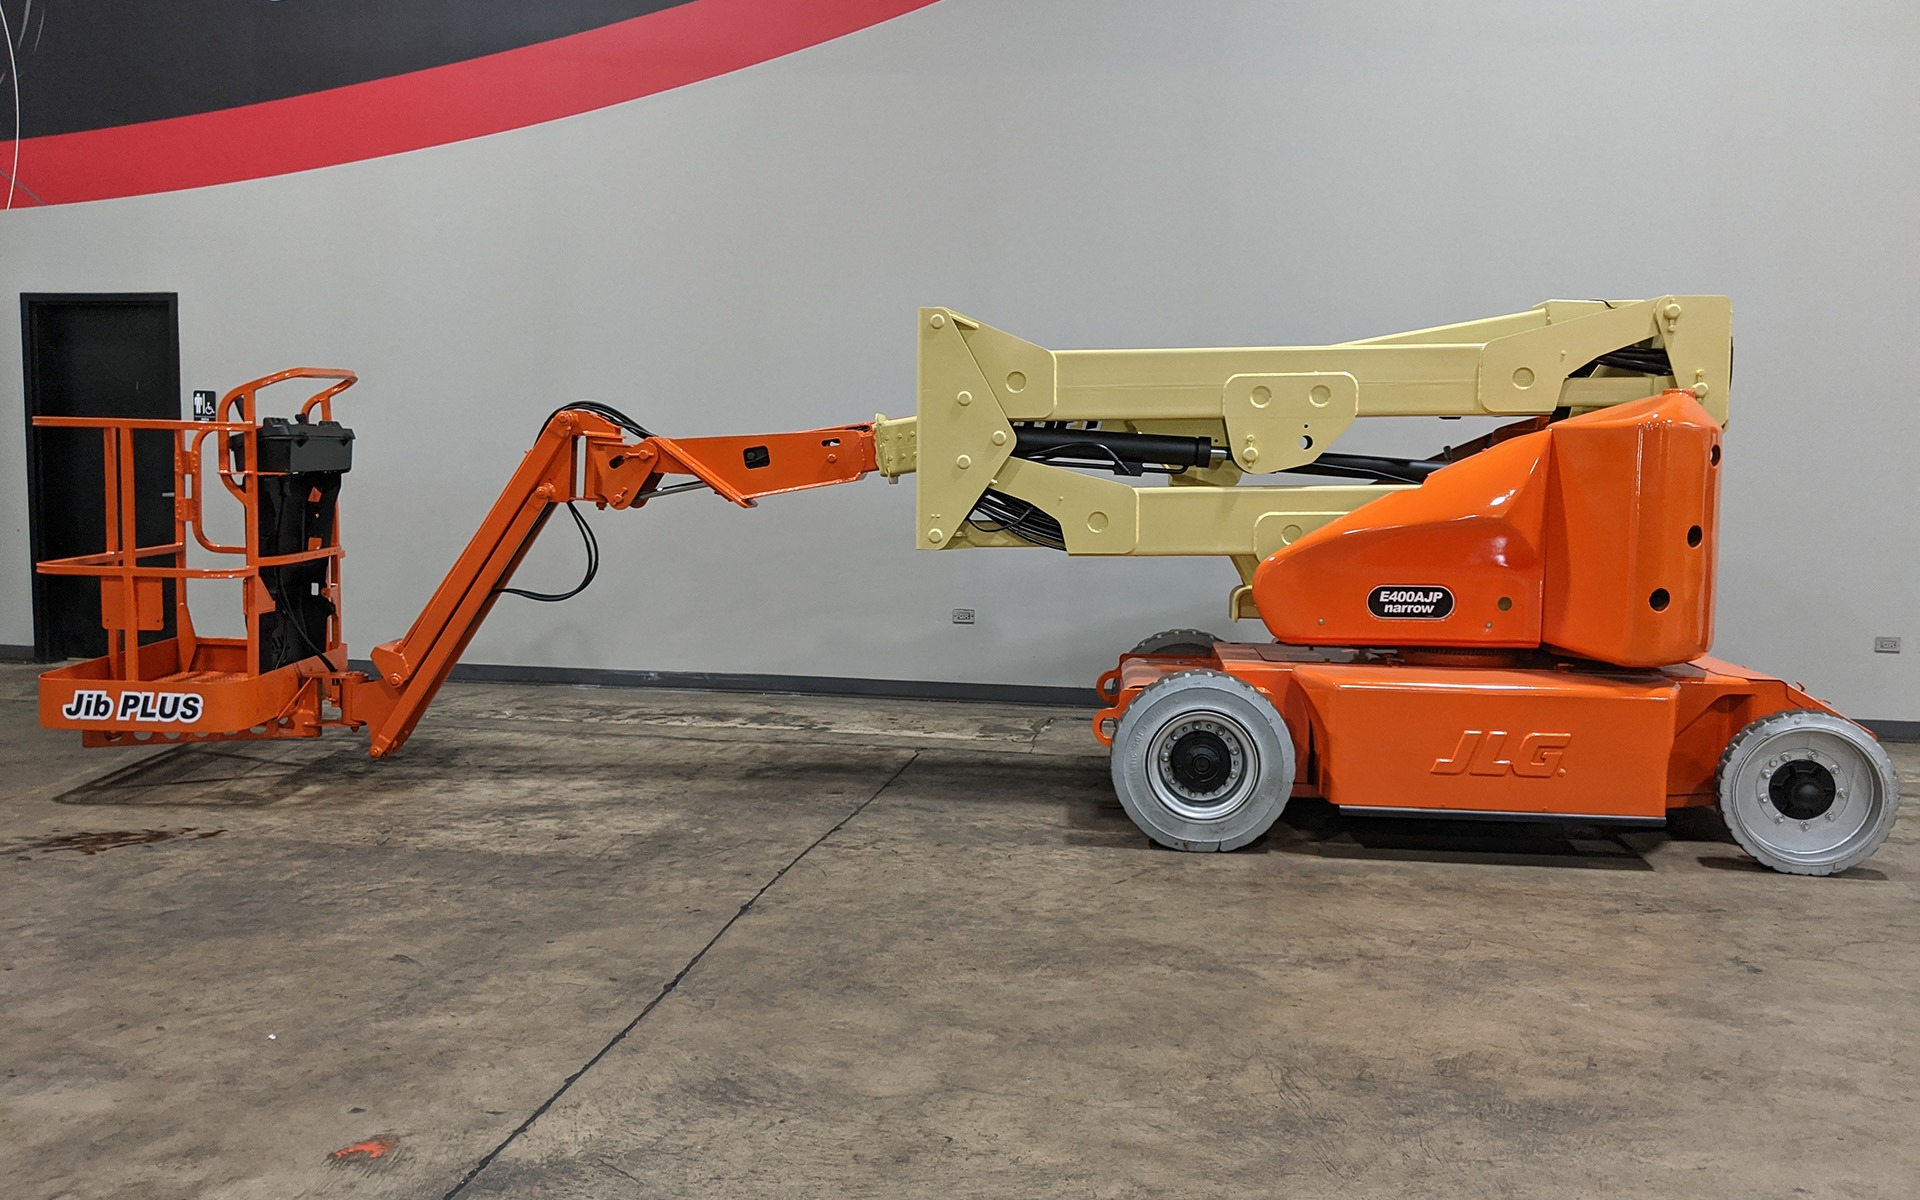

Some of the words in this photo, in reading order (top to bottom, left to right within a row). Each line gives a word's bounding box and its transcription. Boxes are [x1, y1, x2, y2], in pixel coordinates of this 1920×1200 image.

[1379, 590, 1444, 603] E400AJP
[1383, 603, 1435, 614] narrow
[65, 692, 111, 718] Jib
[119, 694, 201, 720] PLUS
[1430, 730, 1571, 778] JLG
